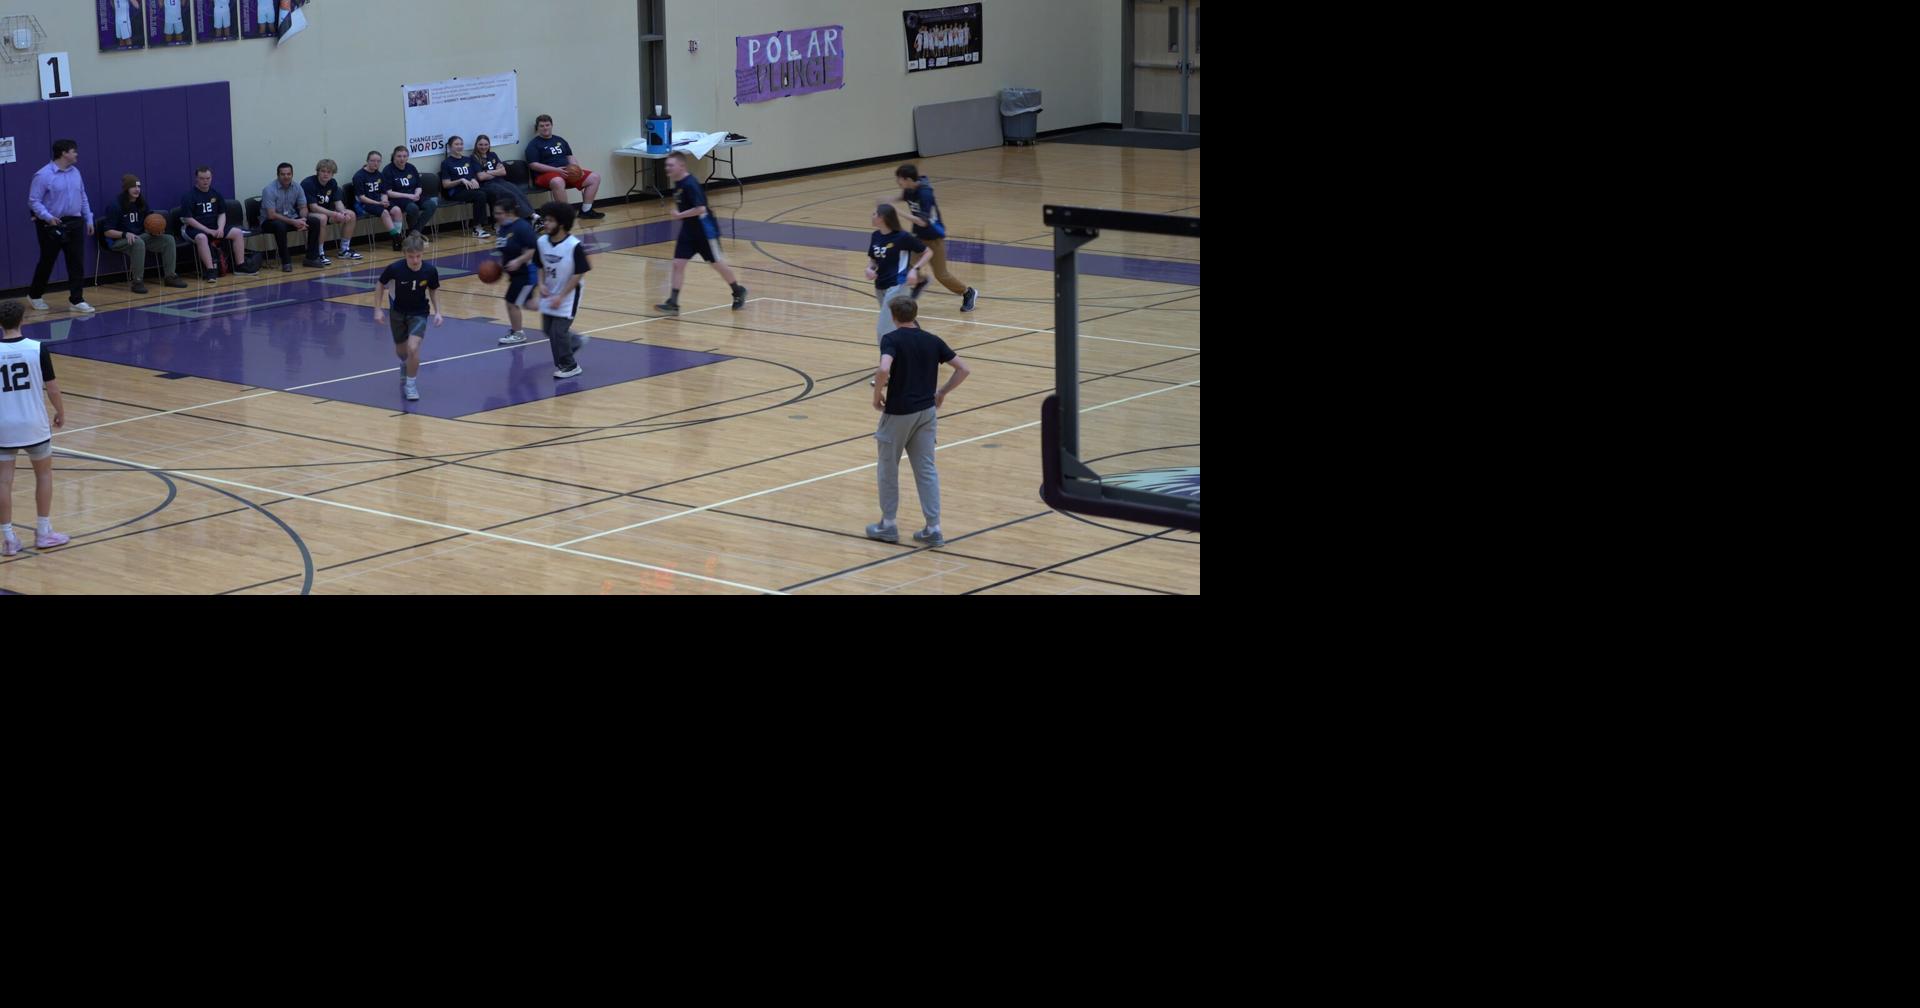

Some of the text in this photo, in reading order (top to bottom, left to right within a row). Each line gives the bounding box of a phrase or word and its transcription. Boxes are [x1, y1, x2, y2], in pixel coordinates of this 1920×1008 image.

[748, 29, 838, 67] POLAR
[47, 56, 69, 98] 1
[410, 136, 431, 144] CHANGE
[410, 140, 444, 153] WORDS
[550, 145, 562, 155] 25
[368, 182, 379, 192] 32
[400, 177, 409, 187] 10
[202, 202, 213, 213] 12
[411, 279, 416, 291] 1
[0, 363, 30, 392] 12
